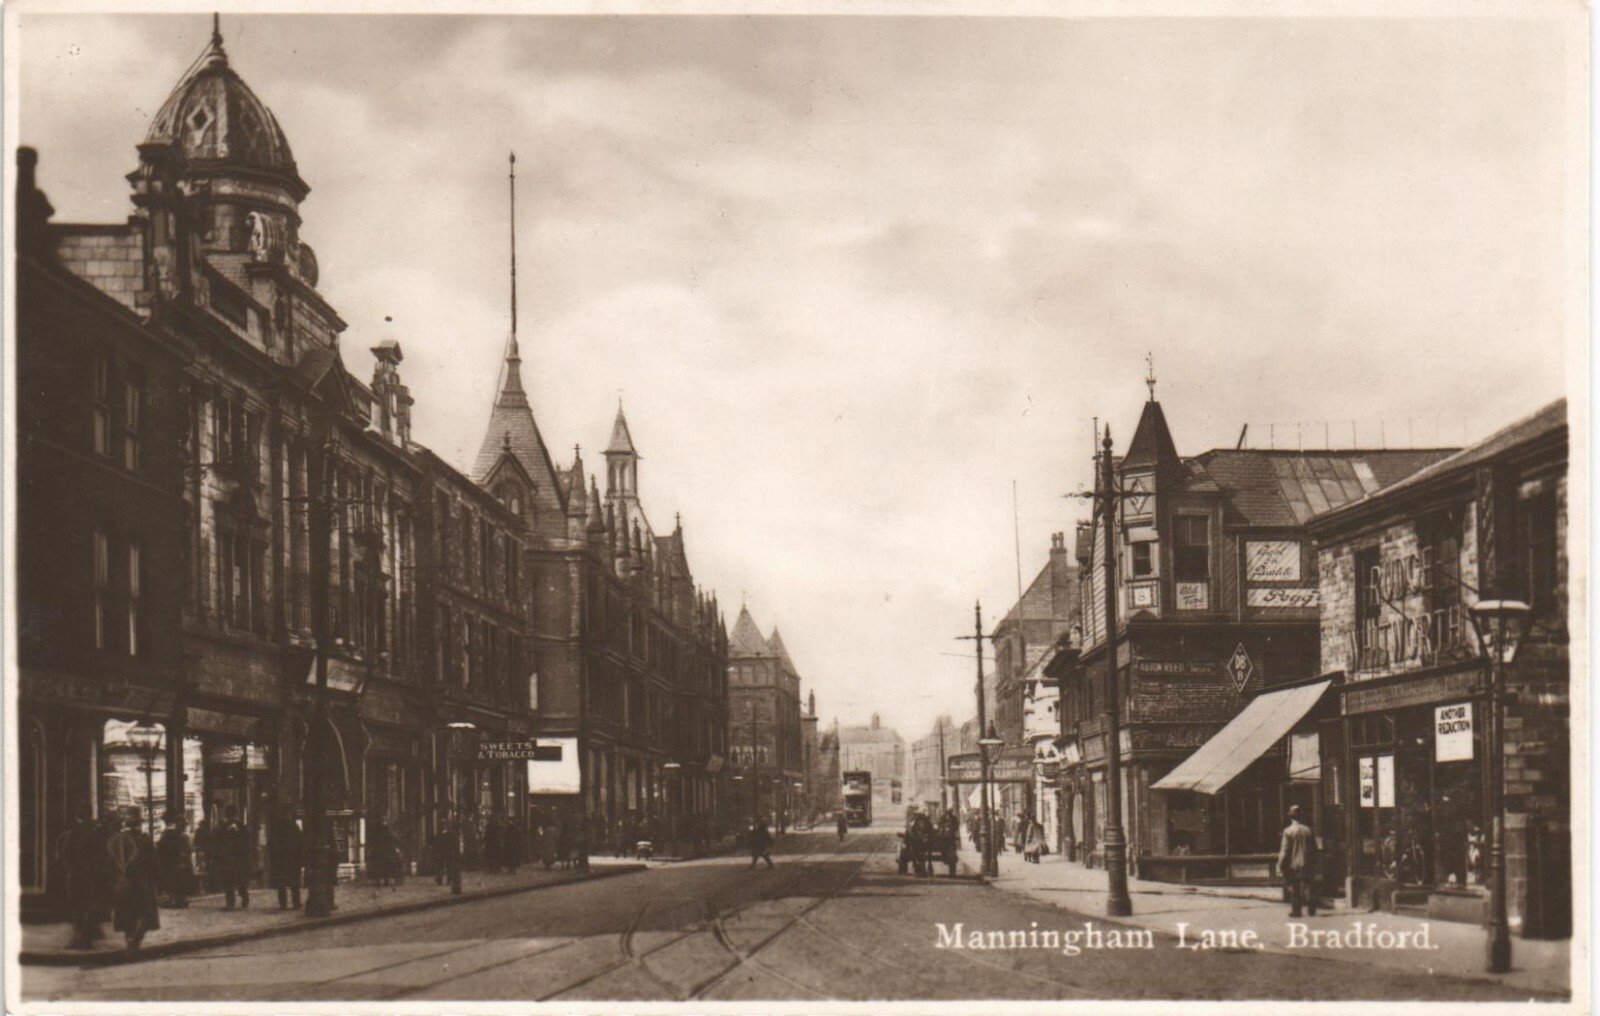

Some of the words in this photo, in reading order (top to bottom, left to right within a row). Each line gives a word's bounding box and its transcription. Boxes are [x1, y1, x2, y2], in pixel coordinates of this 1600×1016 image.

[1440, 707, 1466, 720] ANOTHER
[1438, 720, 1471, 735] REDUCTION
[479, 742, 533, 750] SWEETS
[478, 751, 485, 759] &
[488, 750, 535, 759] TOBACCO
